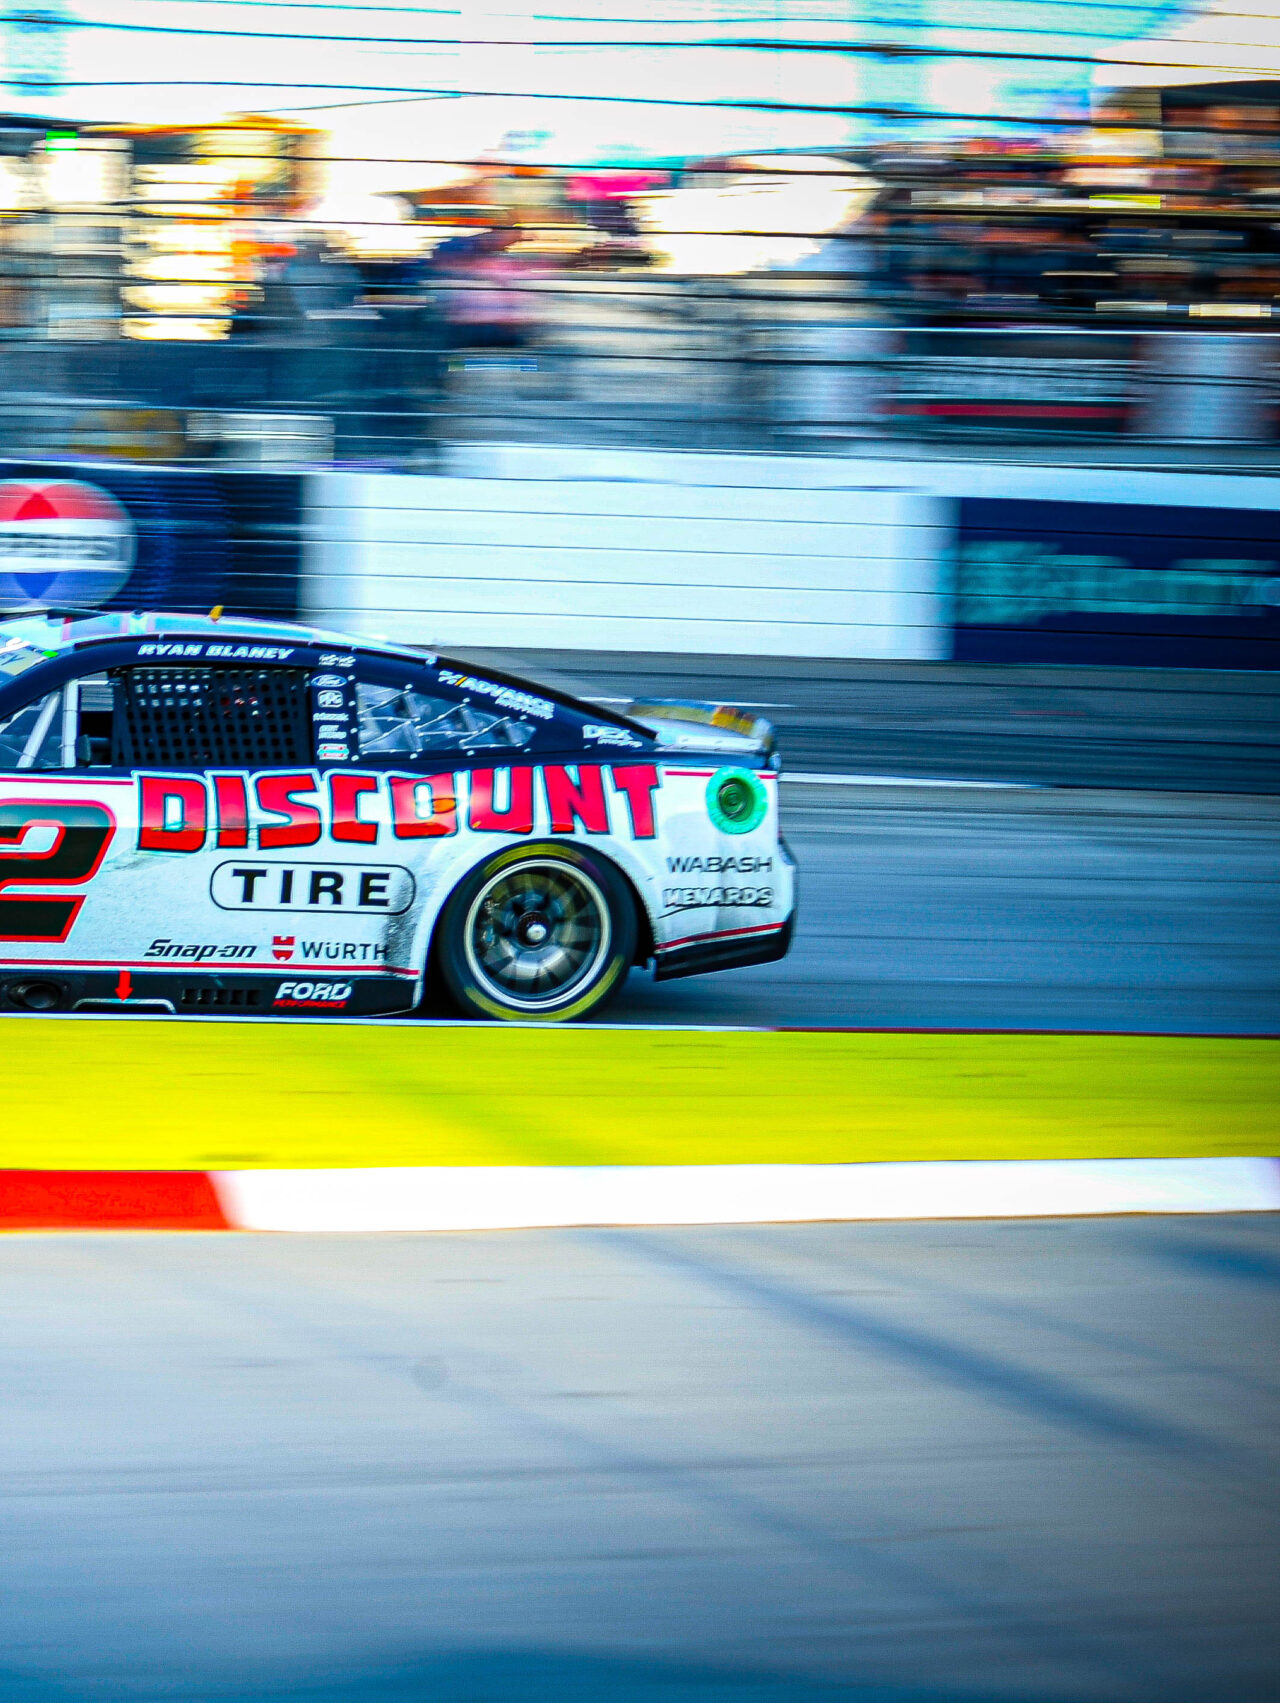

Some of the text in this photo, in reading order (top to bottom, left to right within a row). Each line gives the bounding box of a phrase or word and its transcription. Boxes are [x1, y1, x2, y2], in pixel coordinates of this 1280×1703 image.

[138, 644, 294, 660] RYAN BLANEY
[134, 763, 661, 853] DISCOUNT
[666, 857, 772, 872] WABASH
[232, 868, 392, 907] TIRE
[663, 887, 774, 908] MENARDS
[144, 939, 257, 961] Snap-on
[302, 941, 389, 960] WÜRTH
[275, 982, 353, 1000] FORD
